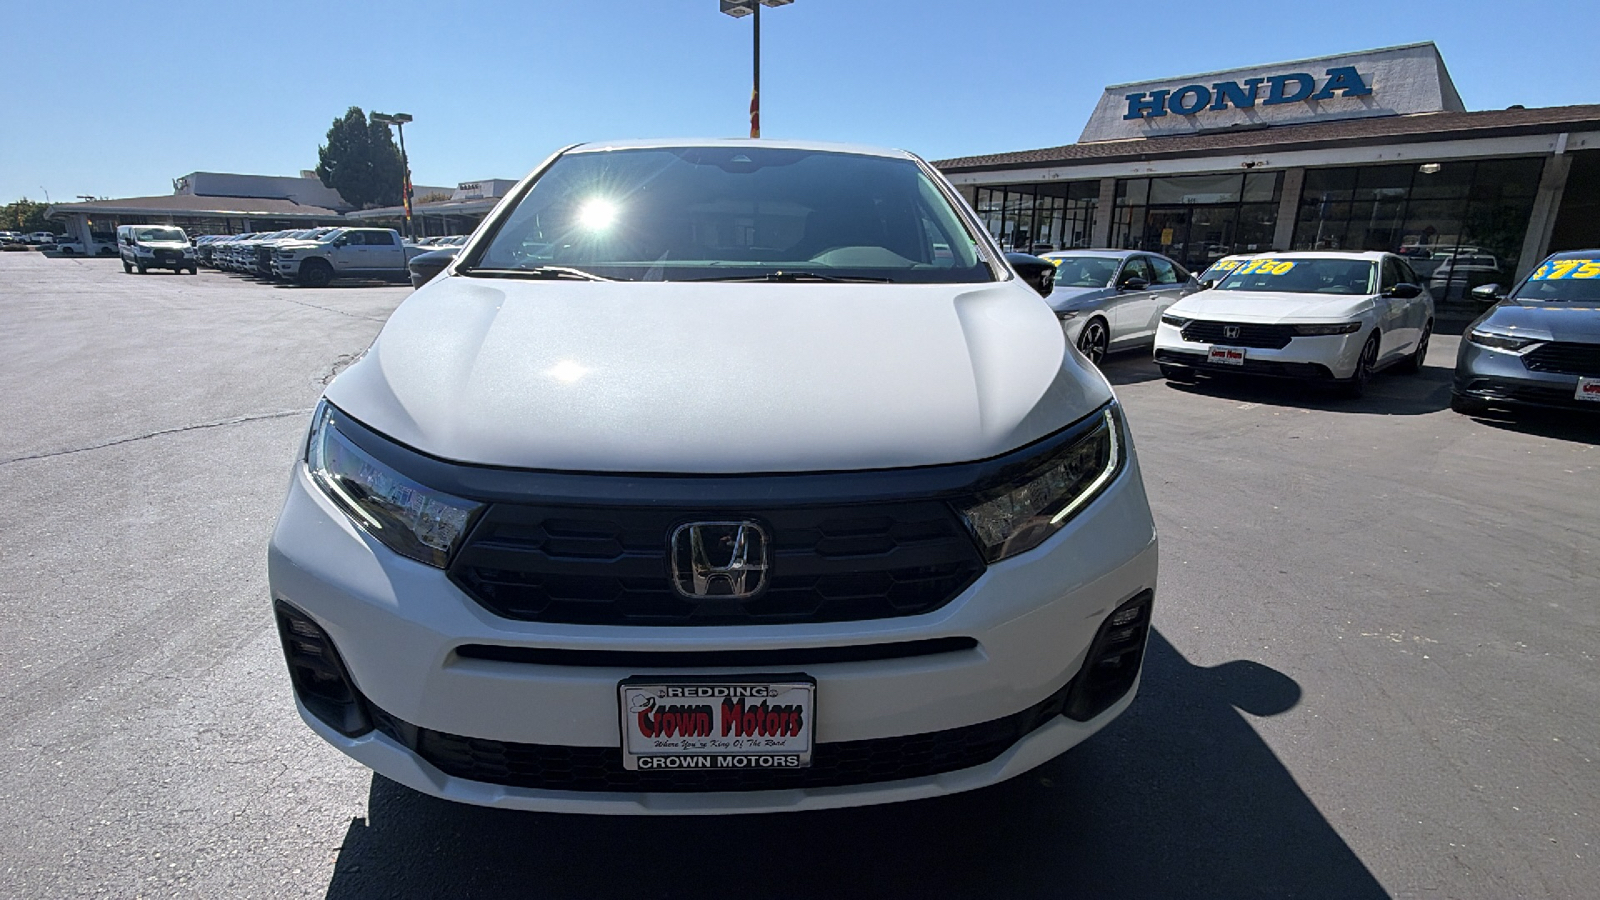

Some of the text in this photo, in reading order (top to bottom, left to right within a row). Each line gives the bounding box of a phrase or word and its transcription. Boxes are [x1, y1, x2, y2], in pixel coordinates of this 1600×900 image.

[1122, 66, 1373, 120] HONDA
[668, 687, 767, 697] REDDING
[637, 697, 803, 738] Crown Motors
[654, 740, 679, 748] Where
[710, 740, 730, 748] King
[747, 739, 761, 747] The
[765, 739, 786, 747] Road
[638, 756, 799, 768] CROWN MOTORS
